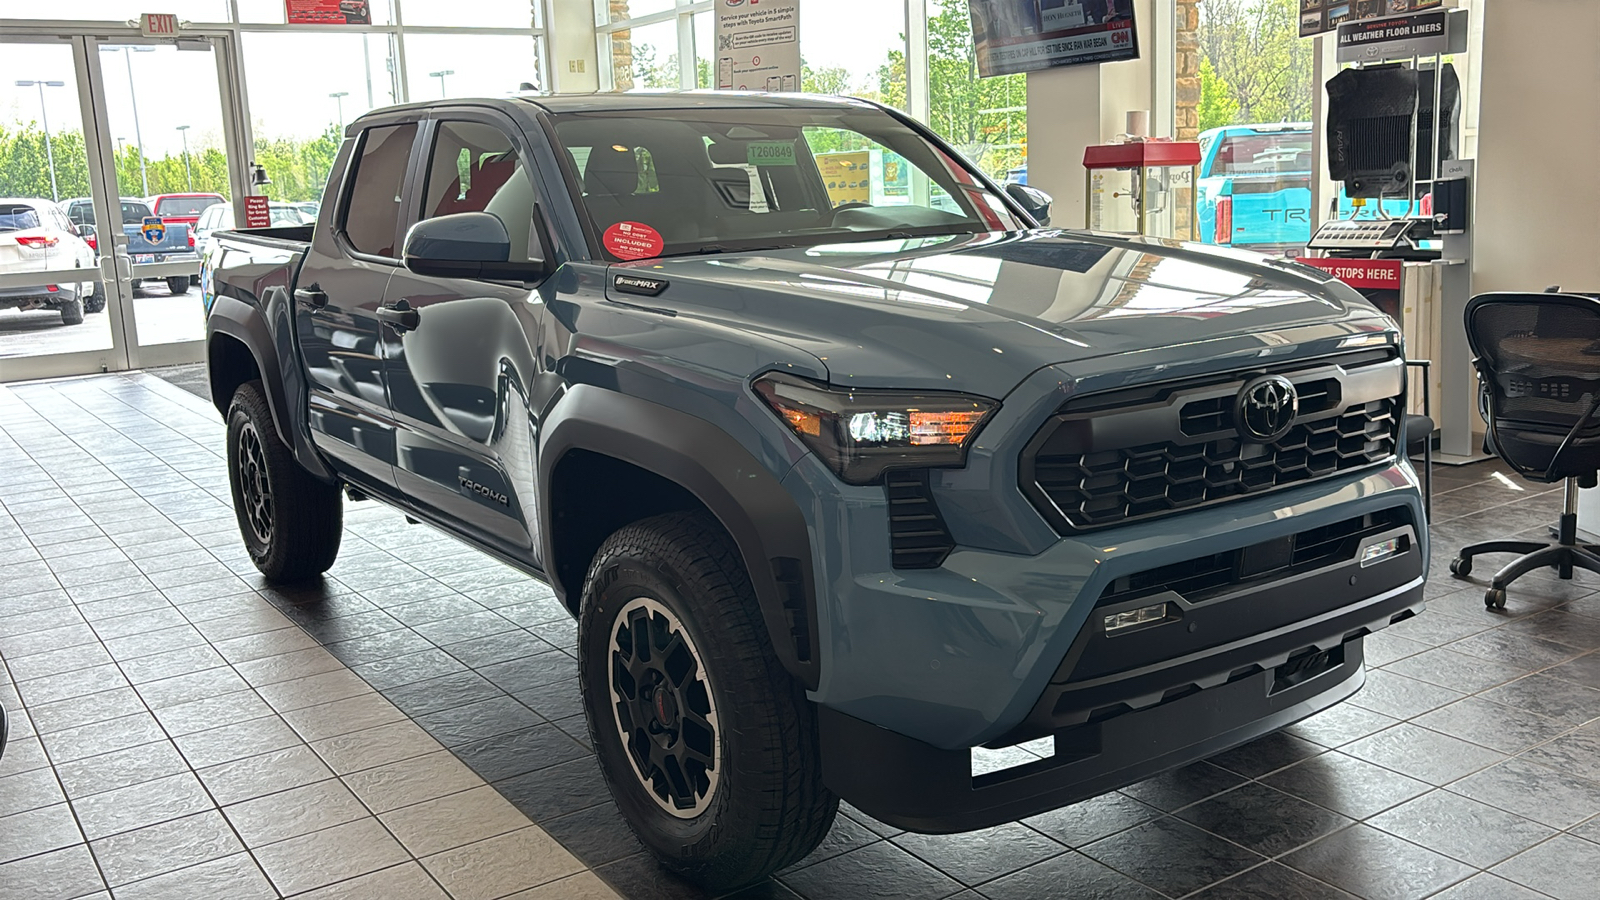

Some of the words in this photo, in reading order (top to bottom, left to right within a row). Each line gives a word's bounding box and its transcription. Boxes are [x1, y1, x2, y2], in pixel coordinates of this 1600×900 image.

[148, 14, 173, 33] EXIT
[765, 14, 792, 22] SmartPath
[1111, 31, 1129, 43] CNN
[1340, 35, 1351, 43] ALL
[1352, 30, 1384, 41] WEATHER
[1386, 26, 1410, 37] FLOOR
[1412, 23, 1442, 34] LINERS
[1062, 42, 1073, 51] SINCE
[1074, 40, 1082, 50] IRAN
[1083, 39, 1092, 48] WAR
[1093, 37, 1107, 48] BEGAN
[750, 146, 792, 158] T260849
[1262, 208, 1311, 223] TR
[614, 237, 652, 248] INCLUDED
[1335, 267, 1364, 278] STOPS
[1367, 269, 1397, 280] HERE.
[458, 476, 509, 507] TACOMA
